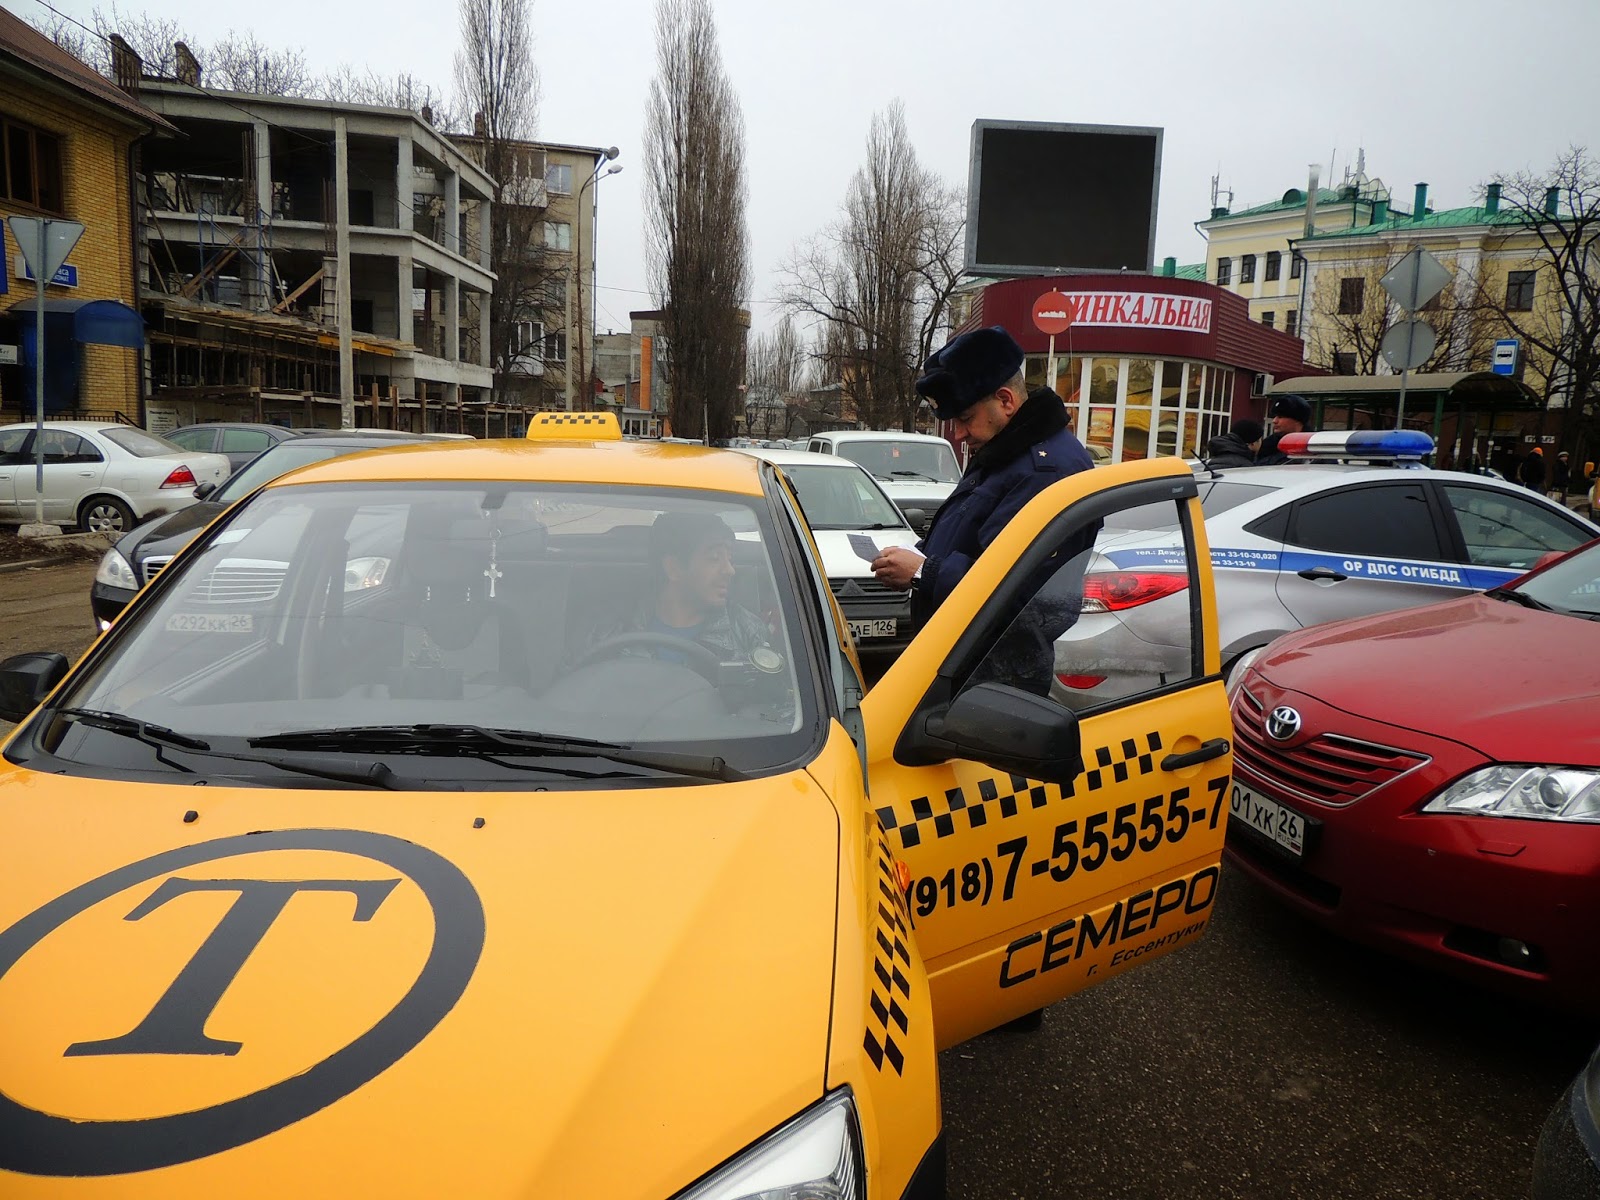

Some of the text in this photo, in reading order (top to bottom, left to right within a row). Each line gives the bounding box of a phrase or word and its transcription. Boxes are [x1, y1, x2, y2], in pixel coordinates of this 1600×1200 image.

[1066, 294, 1212, 330] ИНКАЛЬНАЯ
[1343, 560, 1461, 582] ОР ДПС ОГИБДД
[232, 615, 248, 627] 26
[874, 620, 893, 631] 126
[1278, 809, 1297, 839] 26
[999, 866, 1220, 989] СЕМЕРО
[1086, 920, 1206, 977] г. Ессентуки
